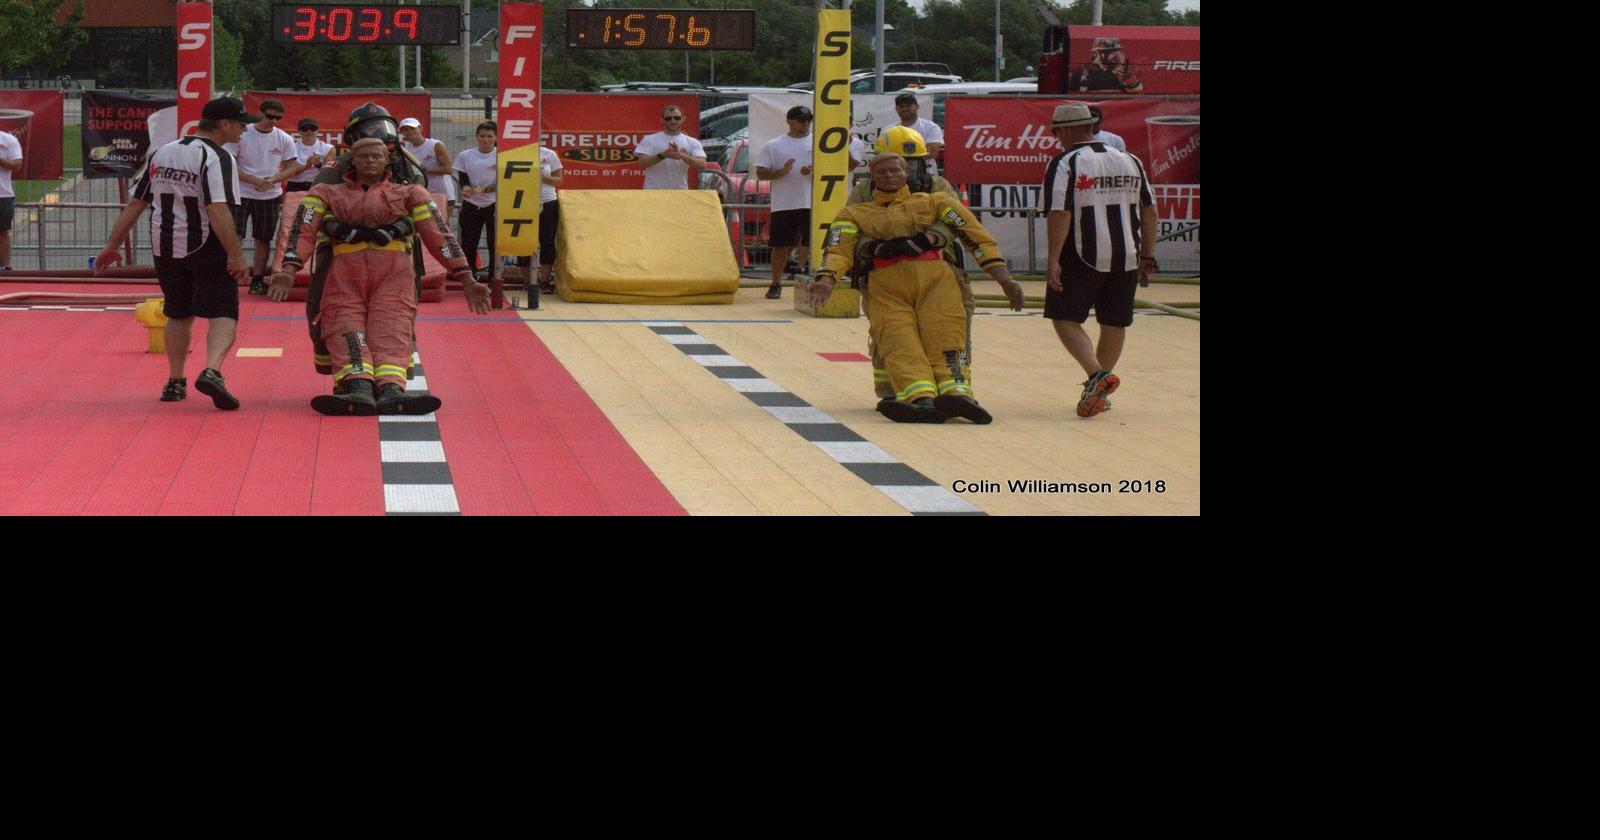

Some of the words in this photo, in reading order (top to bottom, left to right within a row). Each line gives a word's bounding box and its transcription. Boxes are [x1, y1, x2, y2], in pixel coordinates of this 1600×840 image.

[501, 25, 536, 140] FIRE
[88, 106, 113, 118] THE
[963, 124, 1010, 149] Tim
[561, 168, 598, 176] NDED
[1093, 175, 1140, 190] FIREFIT
[503, 161, 534, 238] FIT
